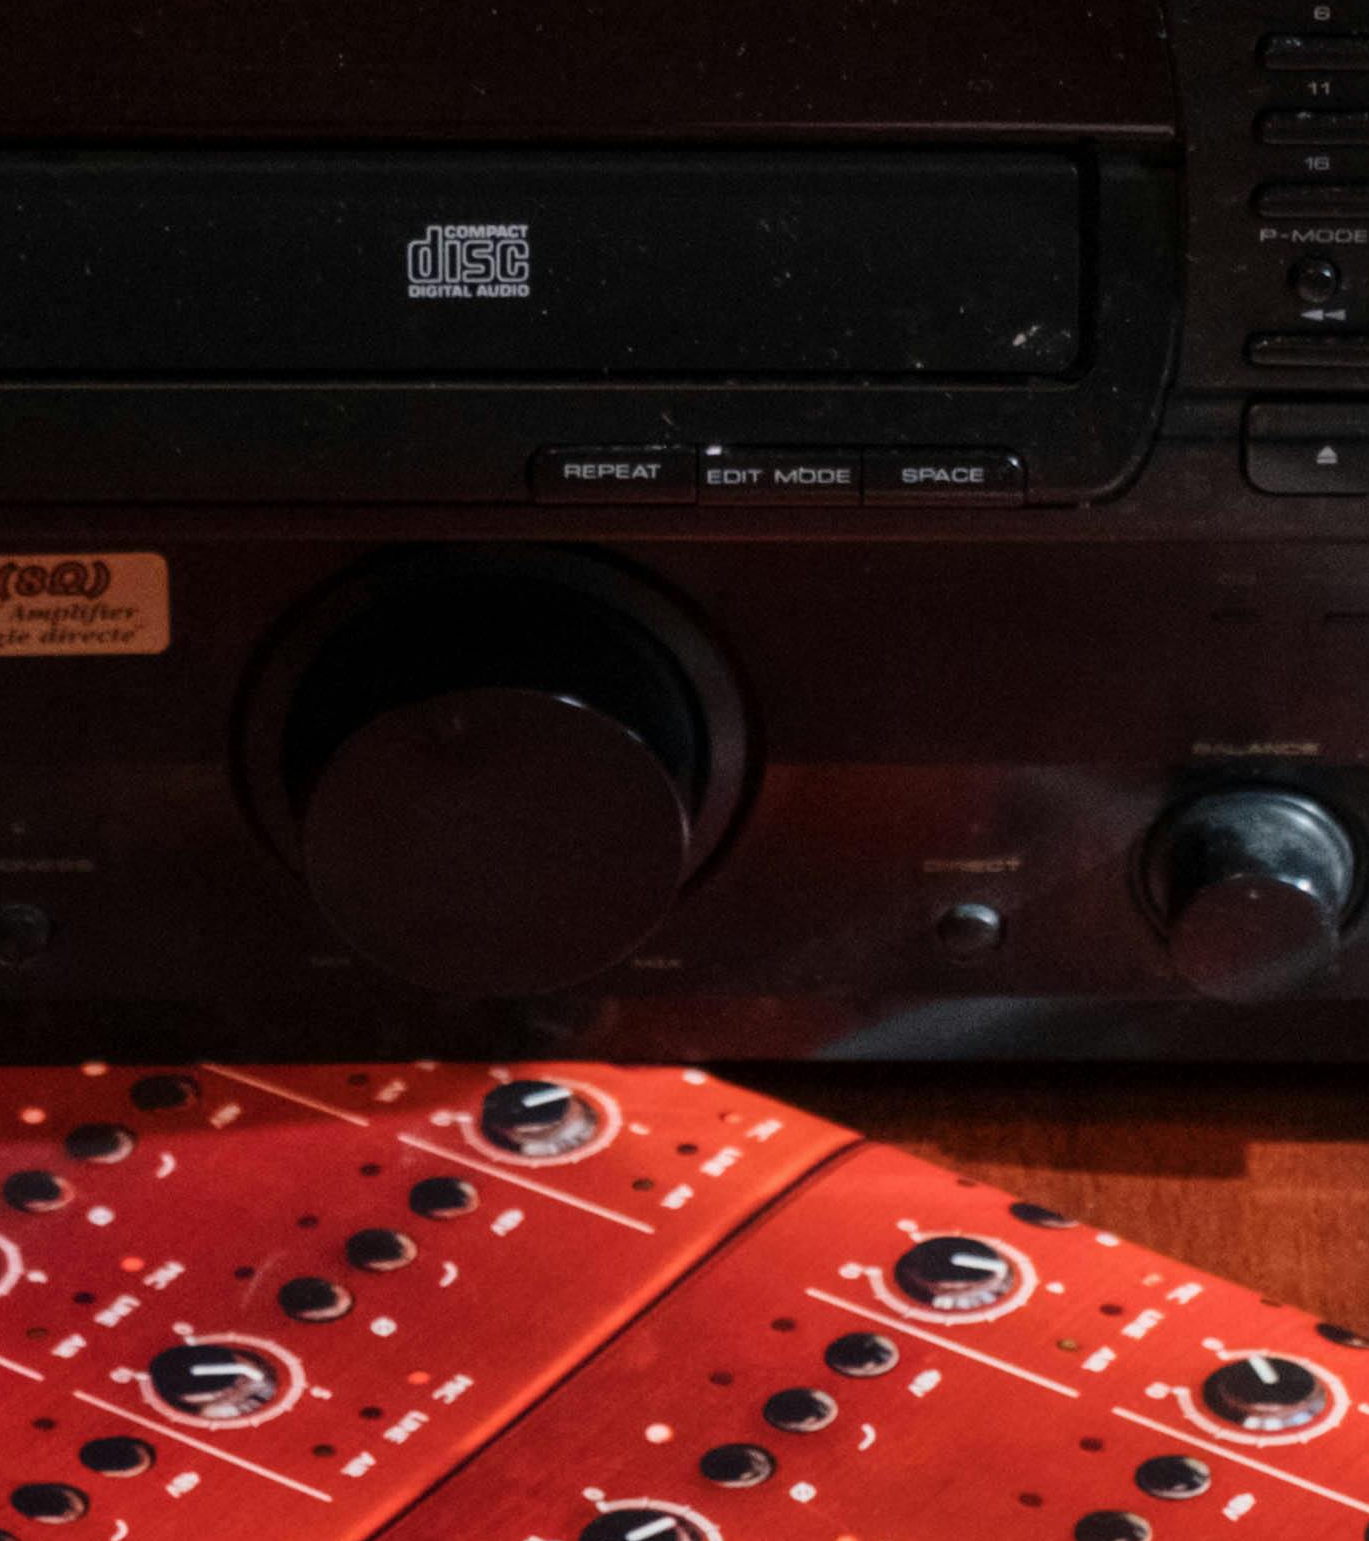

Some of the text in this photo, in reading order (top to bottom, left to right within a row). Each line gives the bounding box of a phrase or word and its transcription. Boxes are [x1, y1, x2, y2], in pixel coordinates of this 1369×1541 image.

[1313, 6, 1330, 21] 6
[1307, 81, 1331, 96] 11
[1304, 156, 1330, 171] 16
[444, 225, 530, 239] COMPACT
[1259, 228, 1369, 244] P-MODE
[407, 225, 530, 284] disc
[407, 284, 531, 299] DIGITAL AUDIO
[562, 460, 663, 481] REPEAT
[705, 466, 852, 484] EDIT MODE
[900, 465, 986, 483] SPACE
[11, 604, 136, 627] Amplifier
